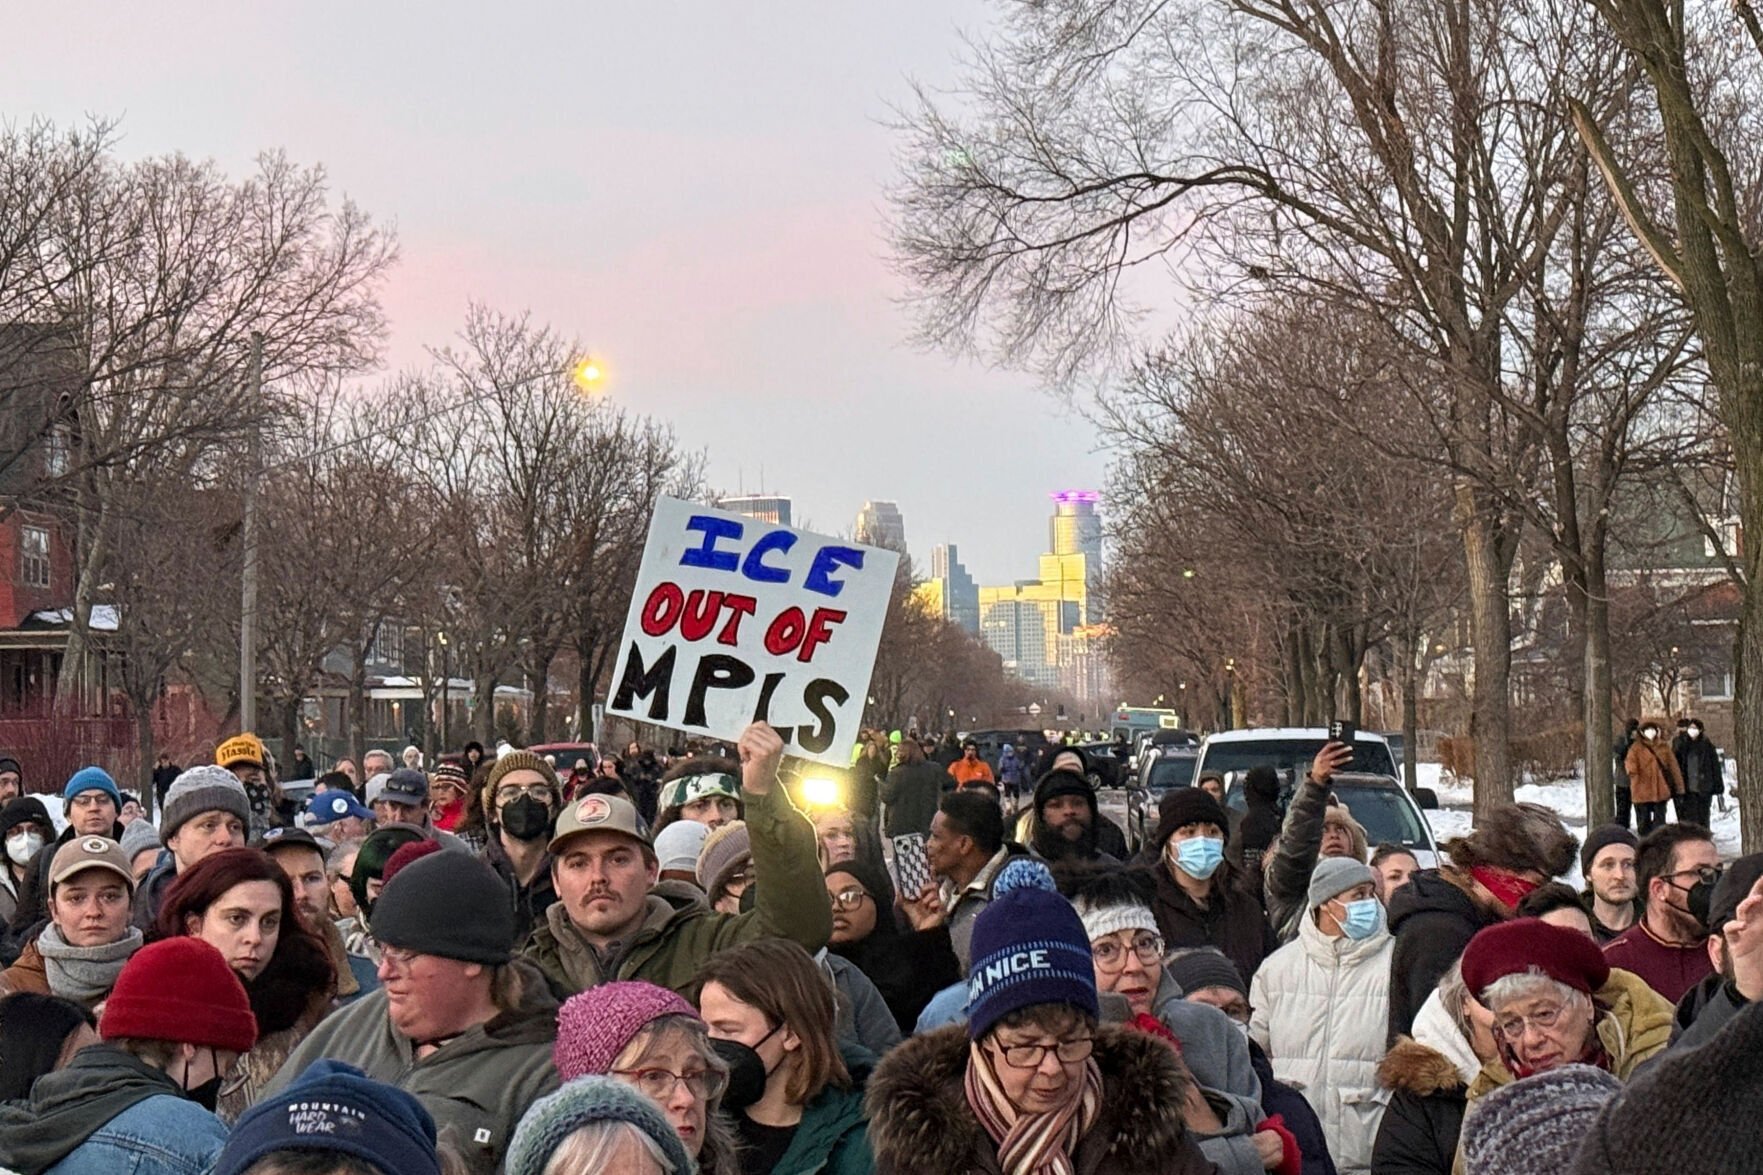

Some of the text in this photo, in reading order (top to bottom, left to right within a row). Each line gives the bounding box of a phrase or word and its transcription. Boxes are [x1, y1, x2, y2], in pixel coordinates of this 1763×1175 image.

[679, 515, 866, 598] ICE
[641, 582, 848, 663] OUT OF
[611, 639, 850, 754] MPLS
[986, 949, 1051, 986] NICE
[288, 1102, 366, 1121] MOUNTAIN
[289, 1111, 327, 1125] HARD
[296, 1121, 336, 1134] WEAR
